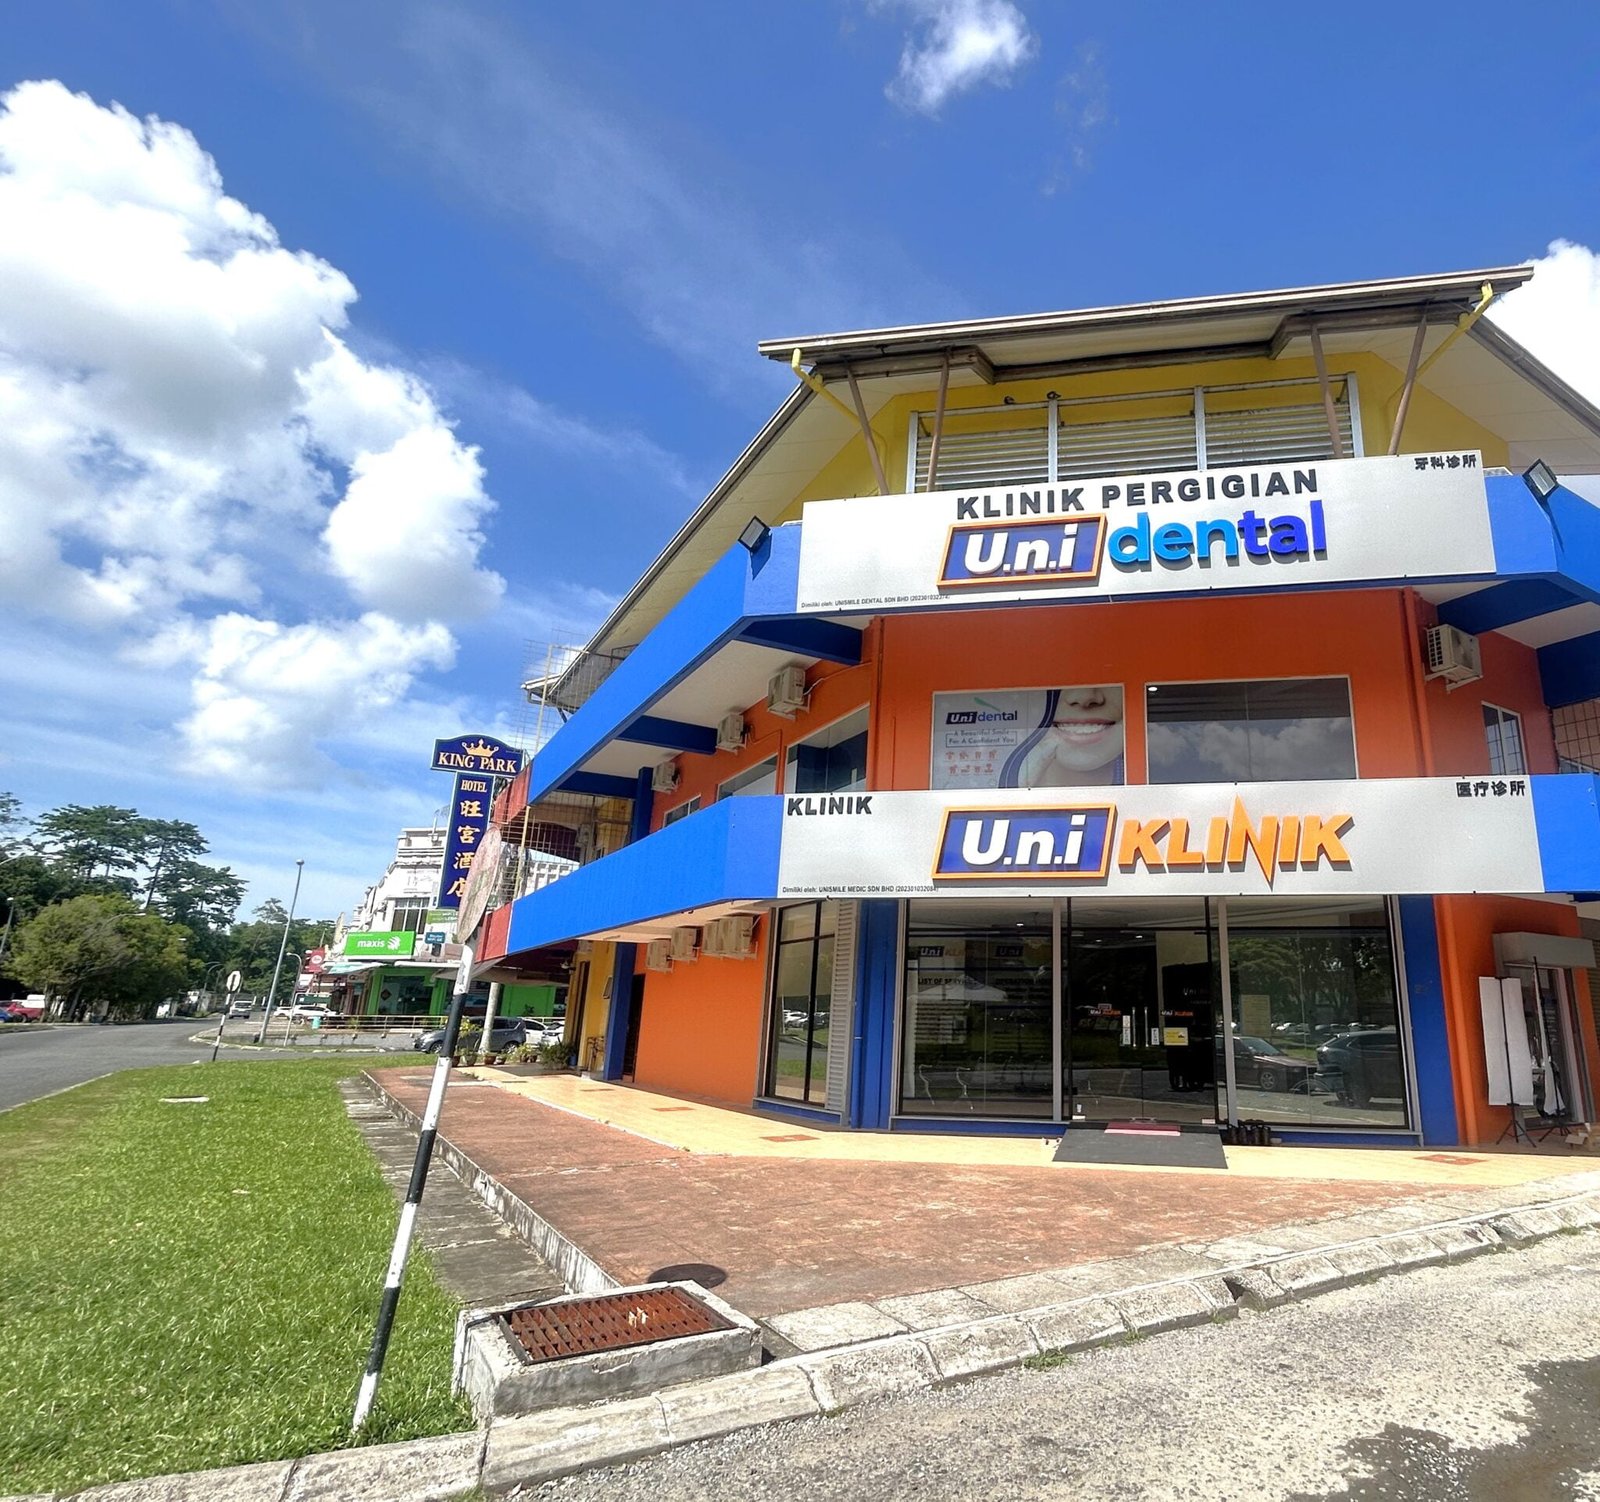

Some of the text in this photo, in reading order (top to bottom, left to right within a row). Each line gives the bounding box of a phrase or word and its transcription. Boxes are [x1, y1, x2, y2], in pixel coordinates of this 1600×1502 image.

[1414, 454, 1477, 470] 牙科诊所
[957, 469, 1319, 520] KLINIK PERGIGIAN
[1107, 499, 1326, 568] dental
[977, 710, 1018, 722] dental
[438, 751, 517, 774] KING PARK
[460, 779, 488, 793] HOTEL
[1456, 780, 1526, 798] 医疗诊所
[787, 796, 873, 816] KLINIK
[1119, 795, 1353, 890] KLINIK
[357, 938, 385, 948] maxis
